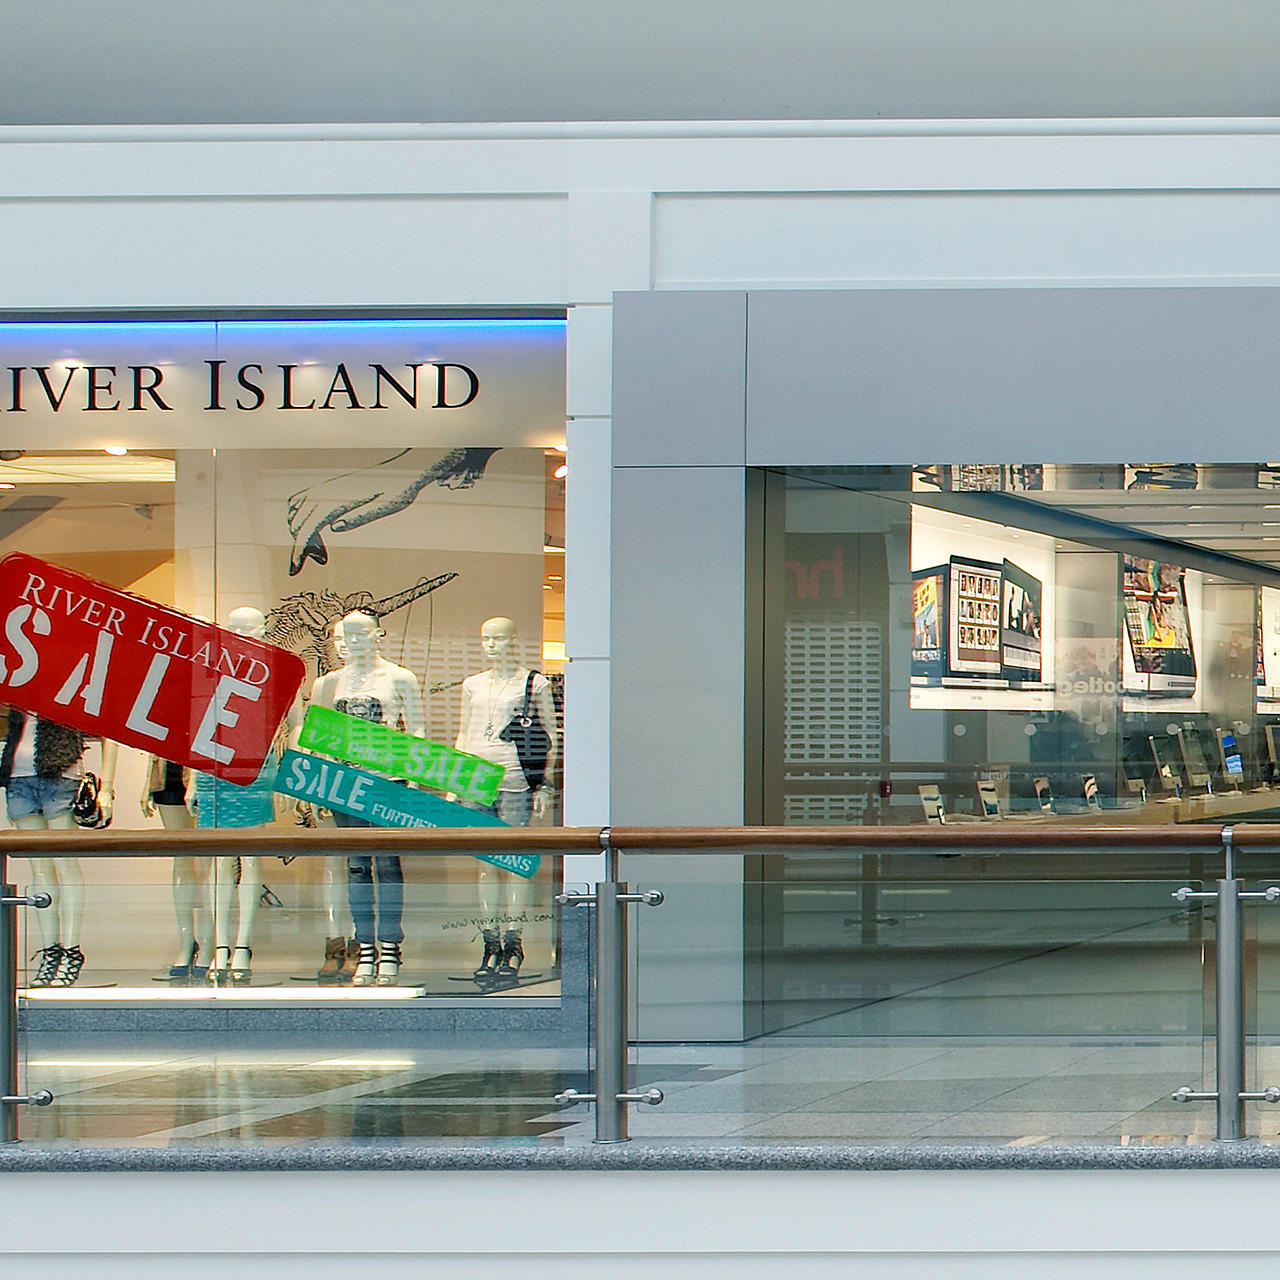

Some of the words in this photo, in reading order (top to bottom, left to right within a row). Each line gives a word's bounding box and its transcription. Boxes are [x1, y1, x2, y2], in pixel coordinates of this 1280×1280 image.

[0, 365, 173, 413] IVER
[203, 359, 481, 411] ISLAND
[19, 573, 126, 636] RIVER
[138, 617, 270, 686] ISLAND
[0, 603, 263, 766] SALE
[285, 756, 375, 811] SALE
[371, 803, 438, 827] FURTHE
[404, 742, 495, 798] SALE
